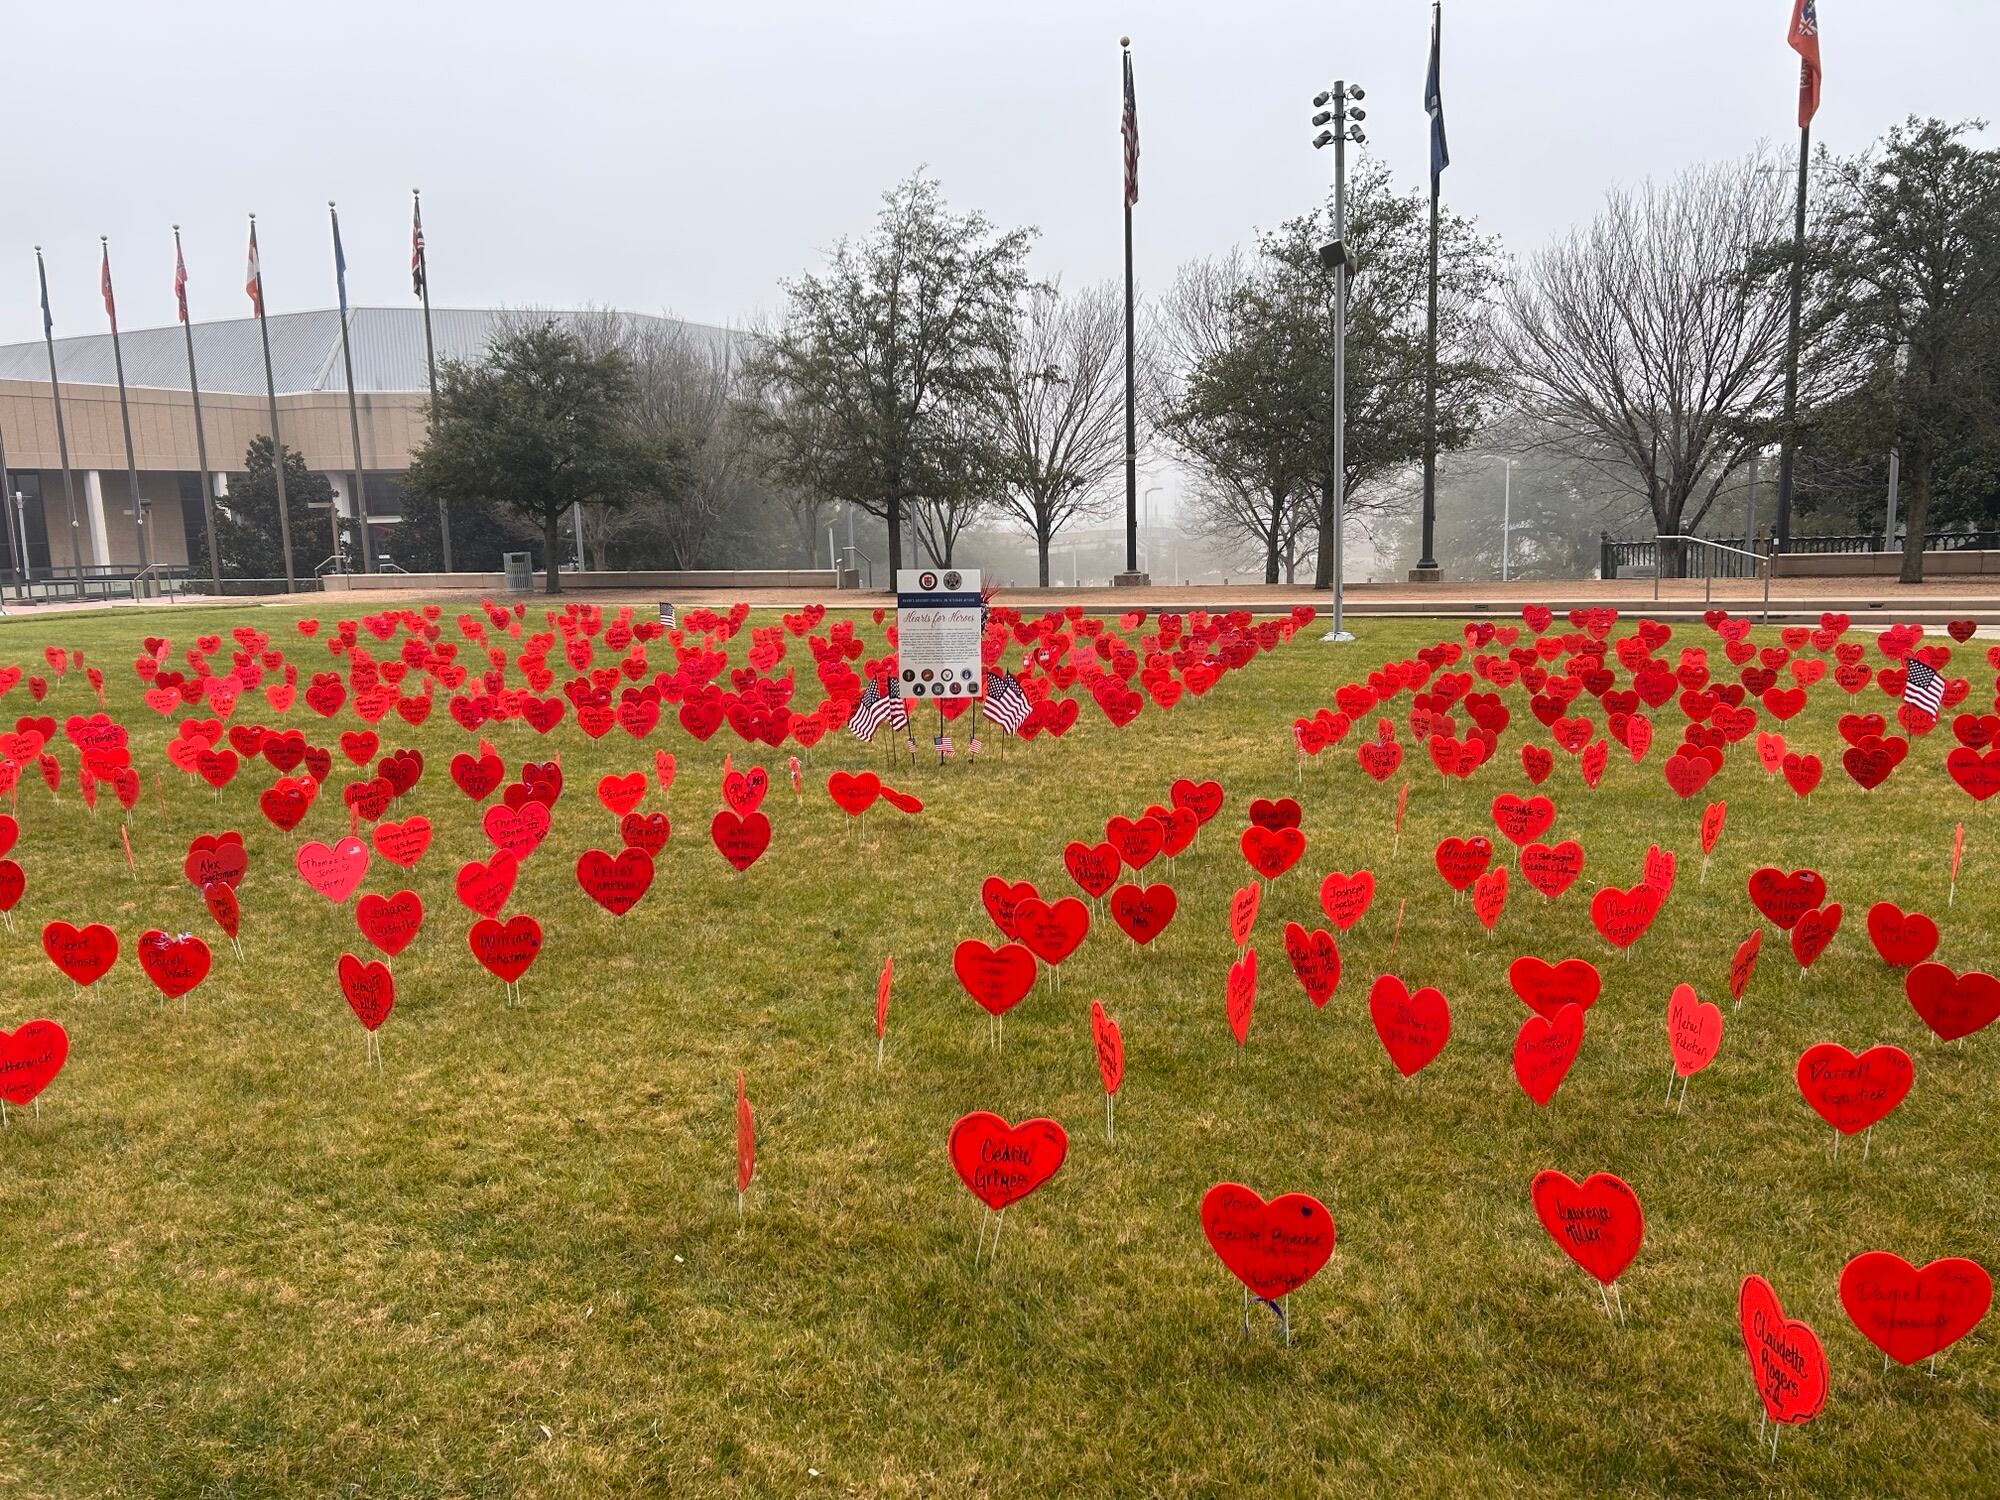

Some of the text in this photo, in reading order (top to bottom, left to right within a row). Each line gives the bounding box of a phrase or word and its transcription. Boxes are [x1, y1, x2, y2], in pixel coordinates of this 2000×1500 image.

[904, 609, 975, 627] Hearts for Heroes
[83, 733, 120, 748] THOMAS
[490, 817, 523, 830] Thomas
[1506, 823, 1526, 834] USA
[200, 859, 221, 873] Alex
[302, 857, 340, 871] Thomas
[1648, 858, 1664, 881] LEE
[1329, 897, 1365, 911] Copeland
[1808, 1058, 1870, 1083] Darrell
[981, 1137, 1031, 1165] Cedric
[974, 1166, 1029, 1188] Grimes
[1565, 1223, 1601, 1247] Miller
[1856, 1280, 1922, 1304] Daniel
[1754, 1309, 1808, 1380] Claudette
[1761, 1347, 1799, 1398] Rogers
